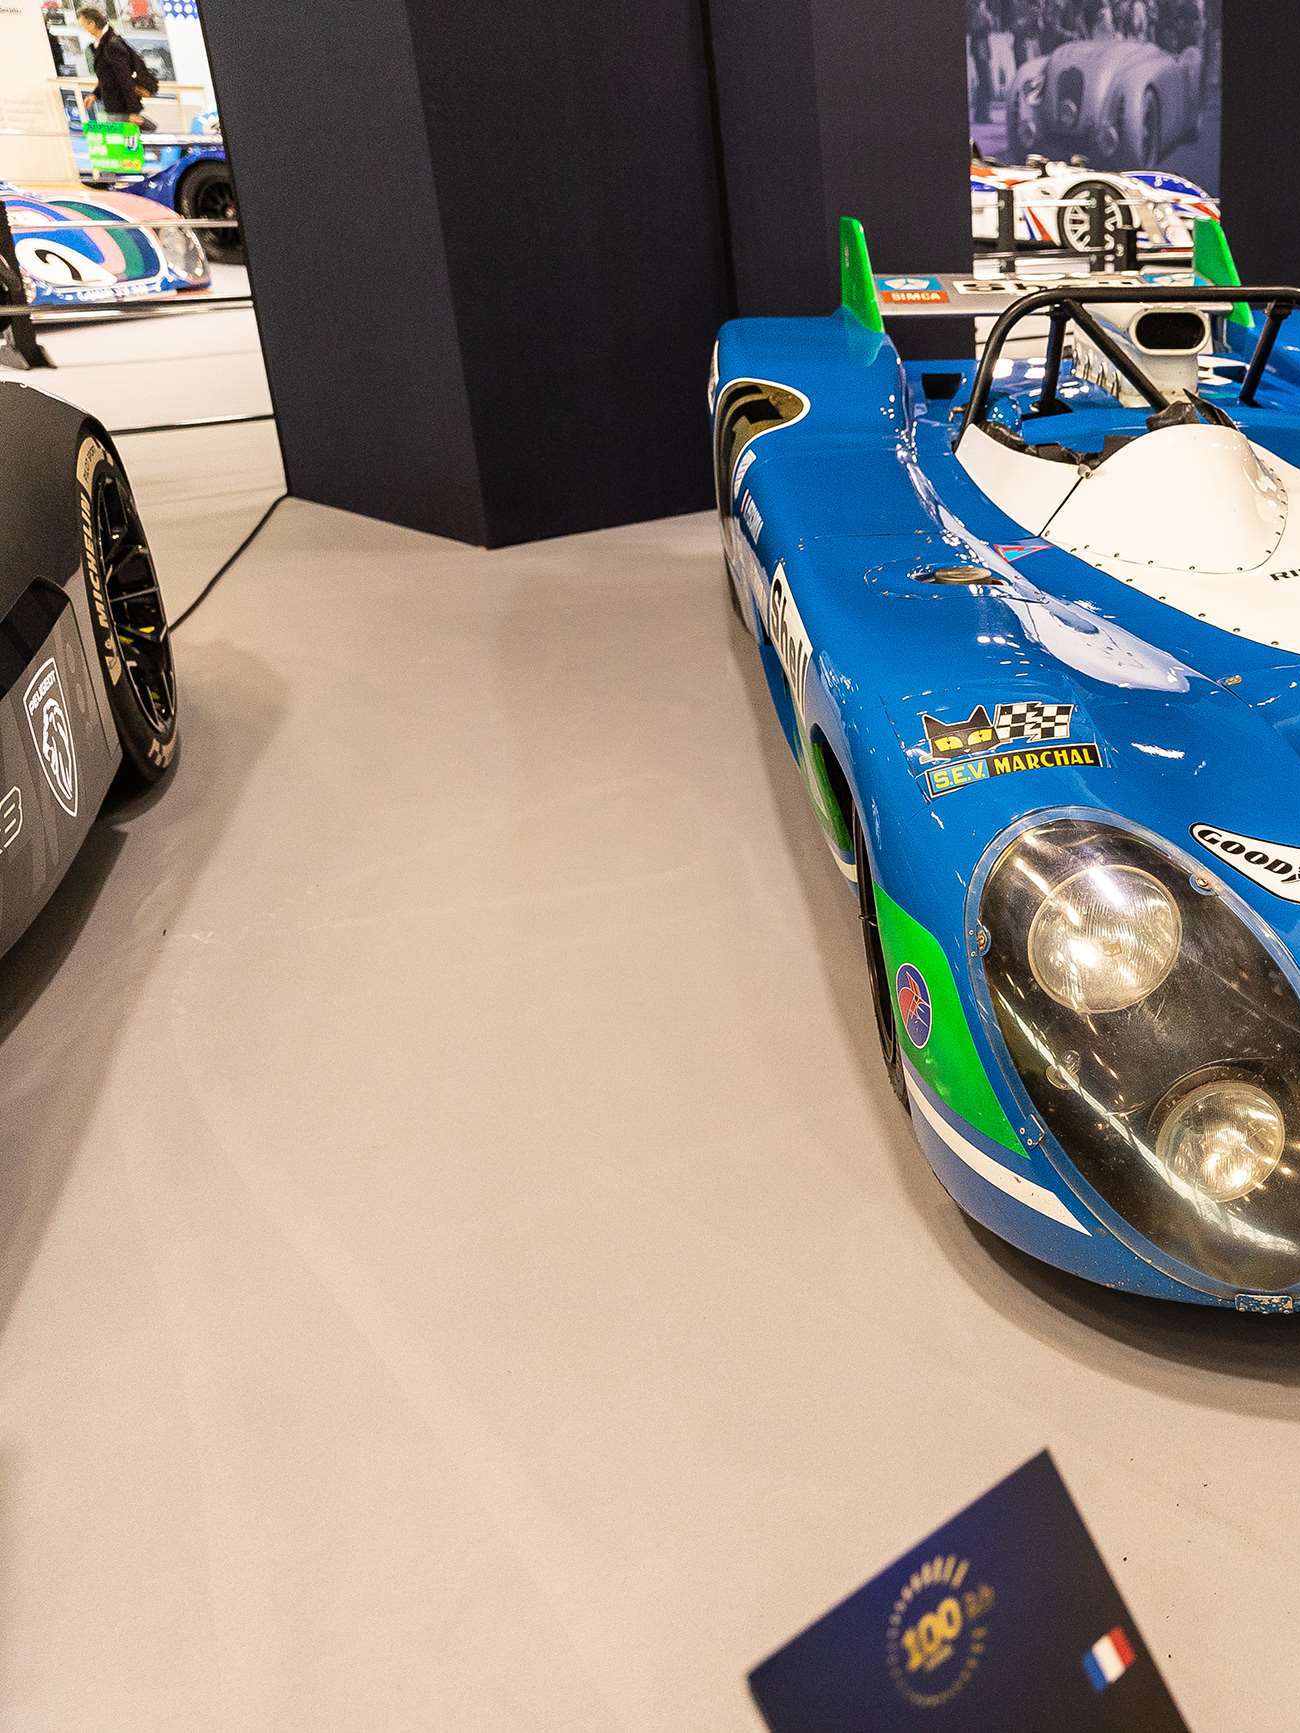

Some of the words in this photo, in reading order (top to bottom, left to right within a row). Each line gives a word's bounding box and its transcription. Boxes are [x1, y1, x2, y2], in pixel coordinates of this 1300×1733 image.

[889, 291, 942, 303] SIMCA
[79, 491, 109, 628] MICHELIN
[28, 670, 57, 716] PEUGEOT
[933, 760, 987, 790] S.E.V.
[994, 747, 1095, 776] MARCHAL
